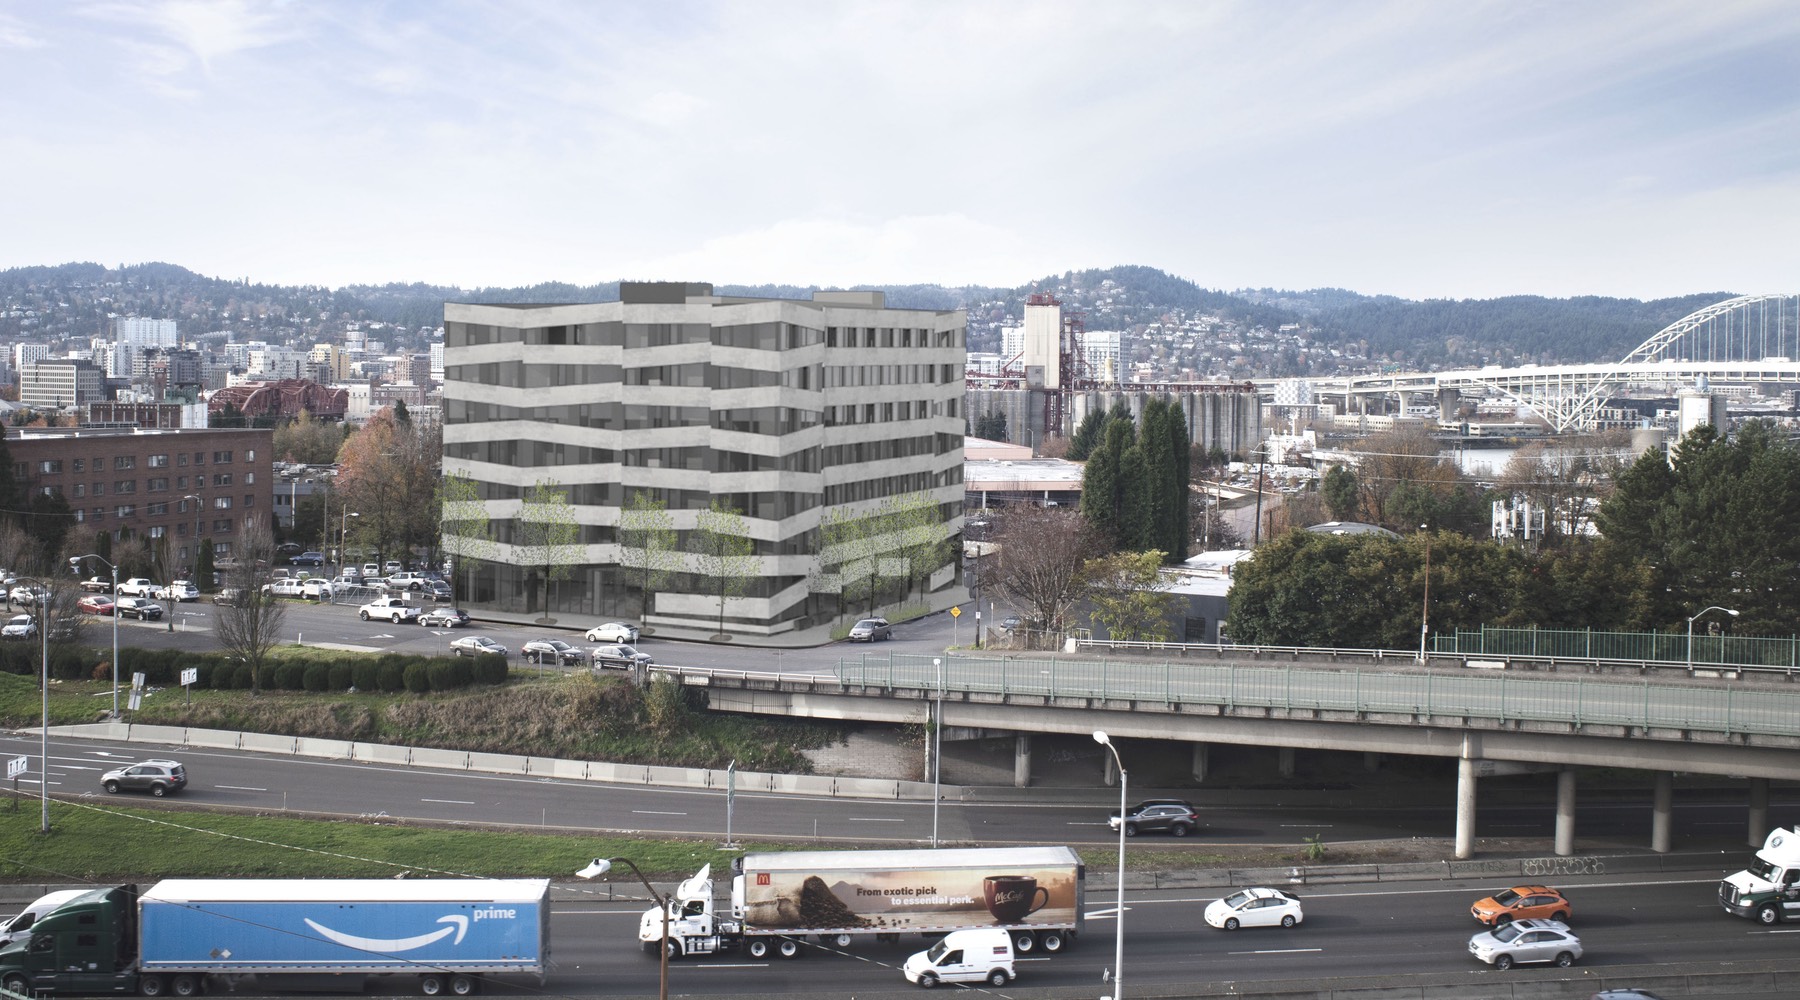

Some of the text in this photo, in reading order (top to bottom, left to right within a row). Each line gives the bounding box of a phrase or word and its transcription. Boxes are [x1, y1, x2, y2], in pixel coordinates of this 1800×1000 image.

[856, 886, 937, 897] From exotic pick
[891, 895, 975, 905] to essential perk.
[473, 906, 516, 922] prime
